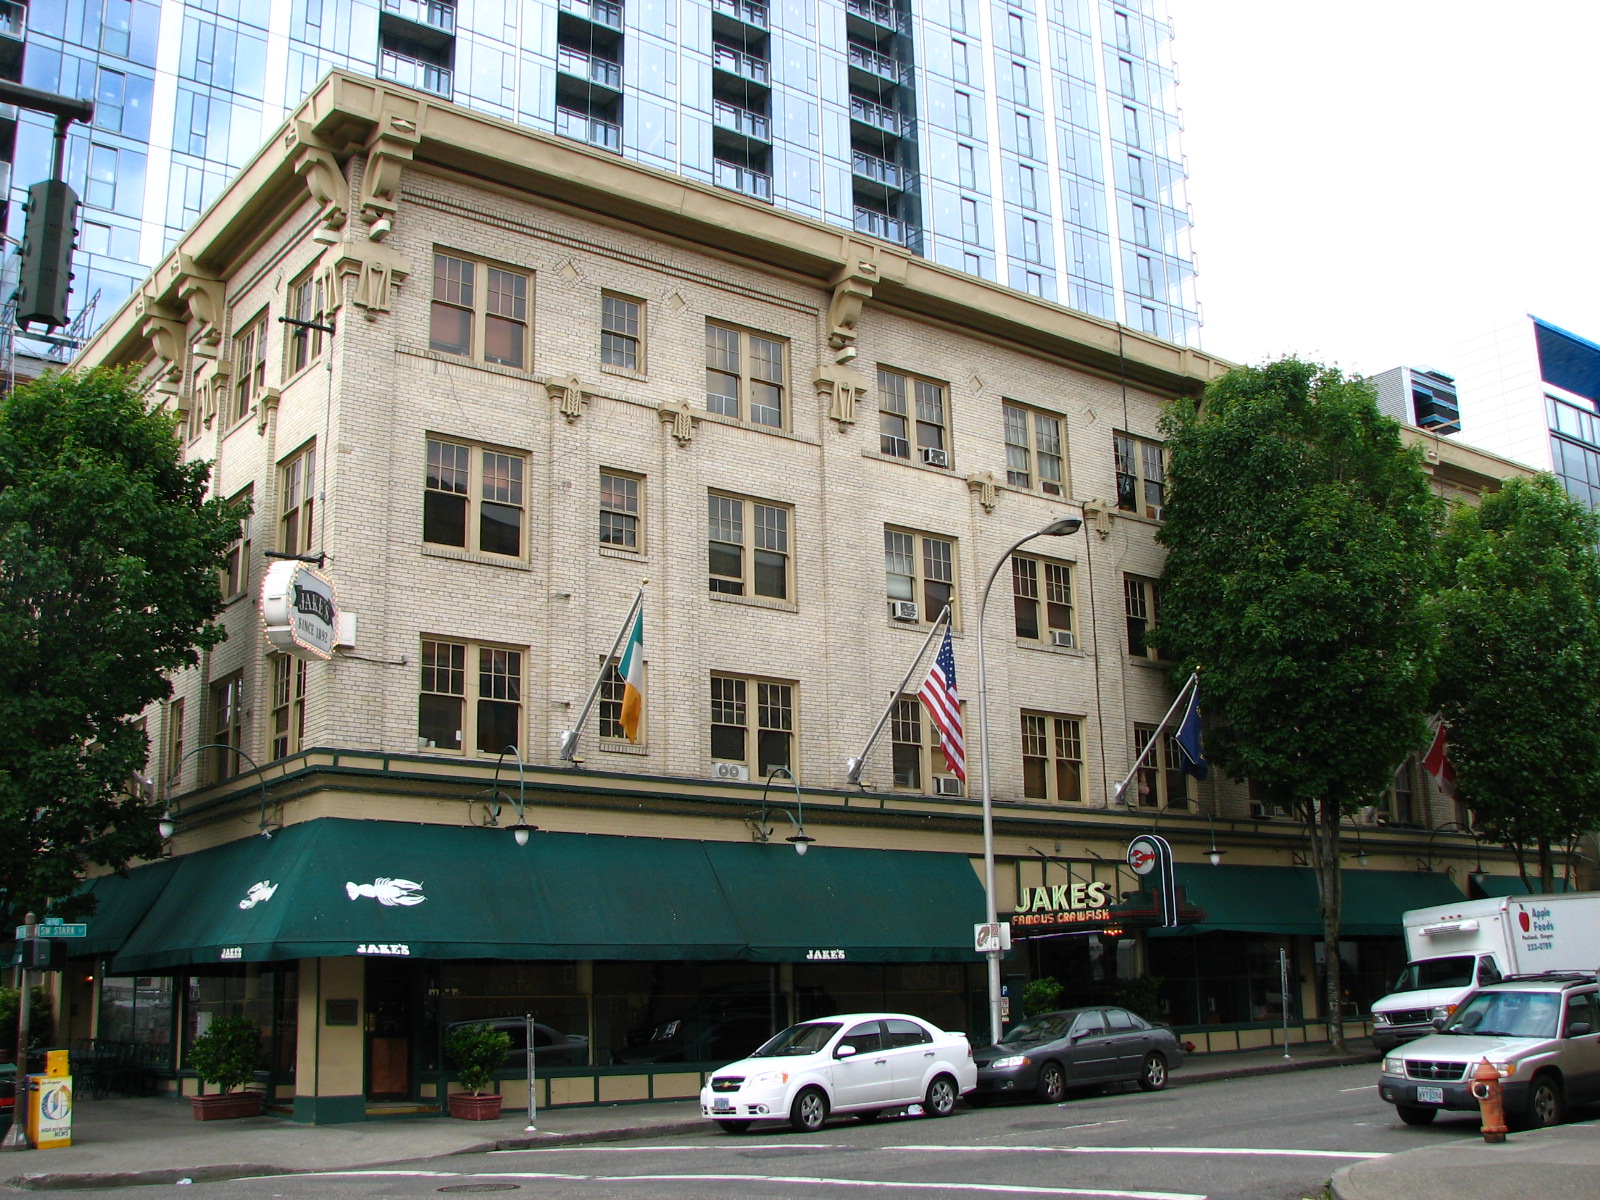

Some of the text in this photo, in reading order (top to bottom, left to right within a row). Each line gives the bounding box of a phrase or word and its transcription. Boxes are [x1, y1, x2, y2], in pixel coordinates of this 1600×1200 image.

[299, 592, 330, 620] JAKE'S
[298, 617, 328, 643] SINCE 1892
[1014, 881, 1106, 913] JAKES
[1013, 908, 1110, 926] FAMOUS CRAWFISH
[1532, 907, 1551, 920] Apple
[41, 926, 51, 935] SW
[54, 926, 76, 935] STARK
[1533, 920, 1554, 931] Foods
[221, 946, 243, 959] JAKE'S
[356, 943, 410, 956] JAKE'S
[806, 948, 846, 960] JAKE'S
